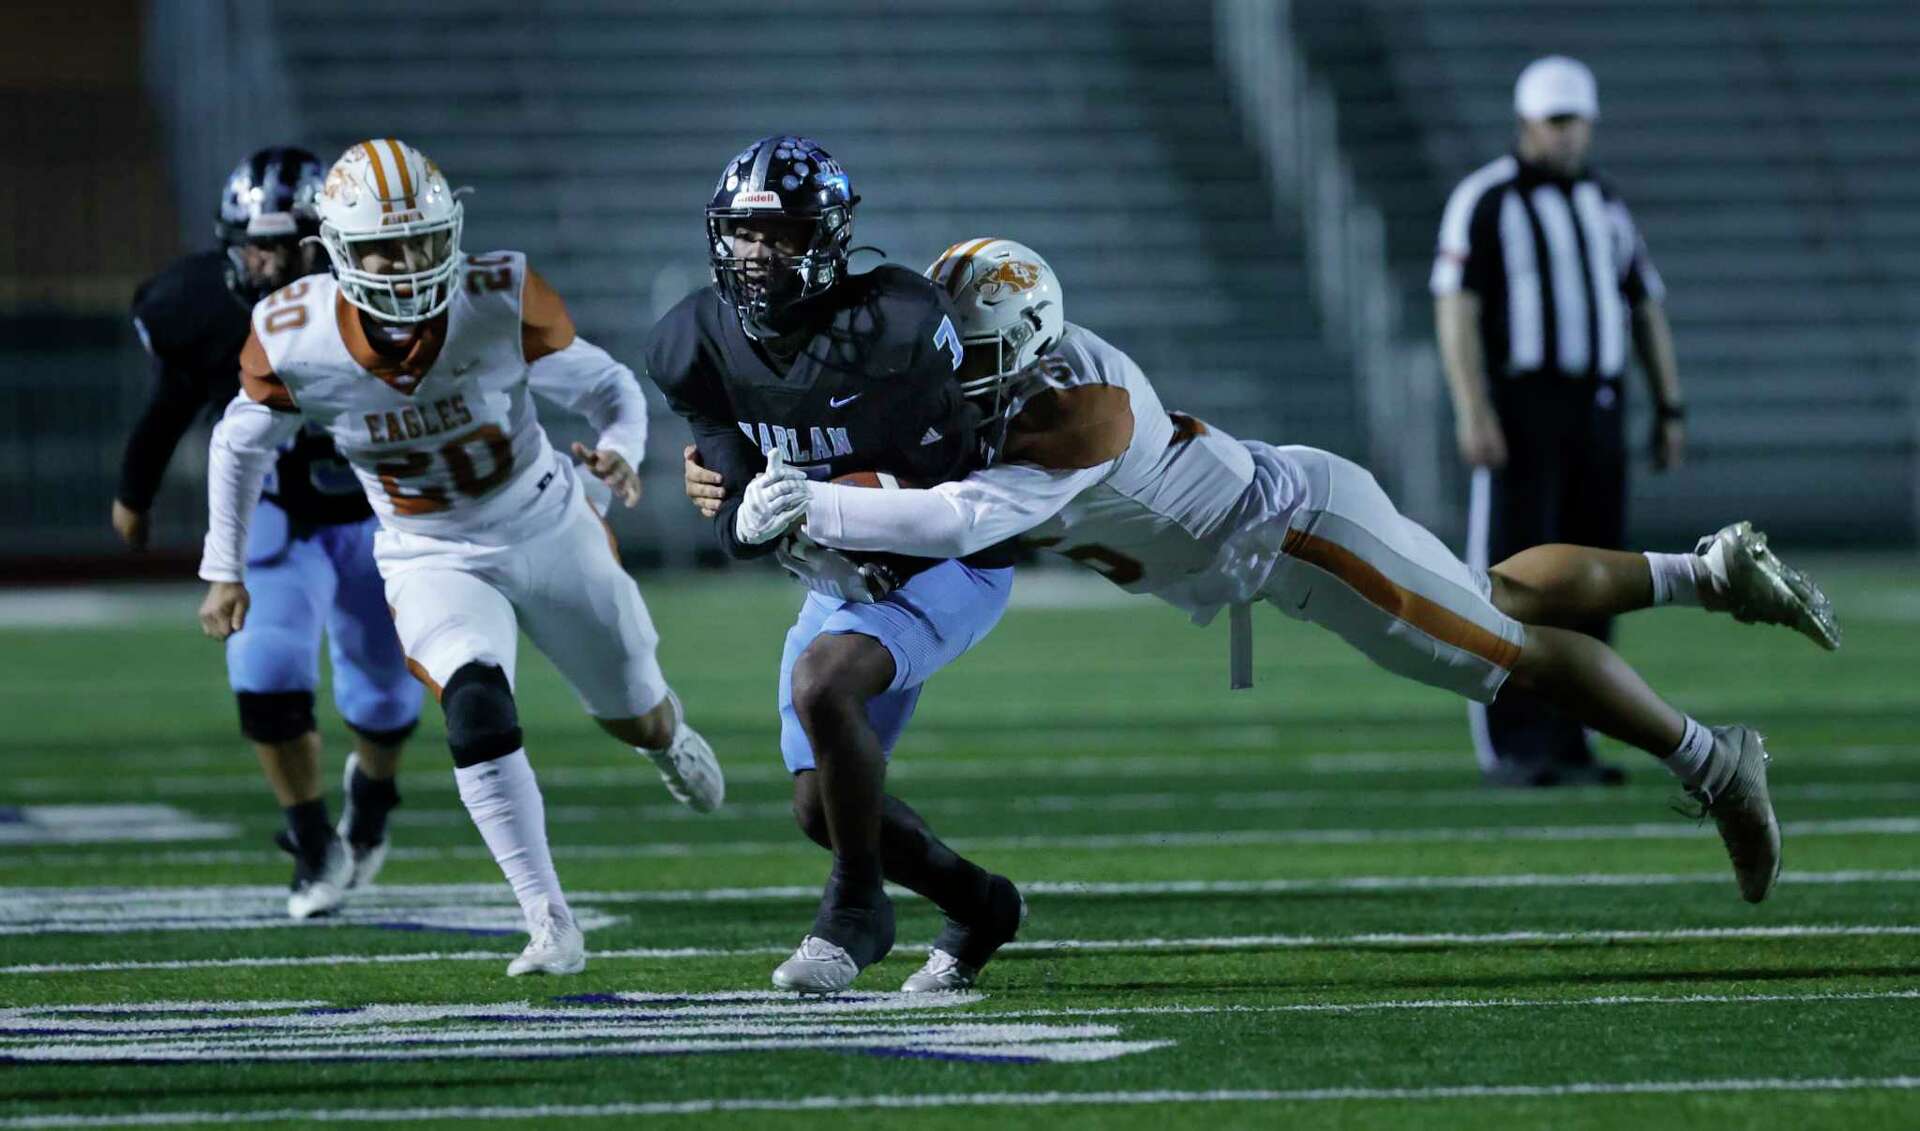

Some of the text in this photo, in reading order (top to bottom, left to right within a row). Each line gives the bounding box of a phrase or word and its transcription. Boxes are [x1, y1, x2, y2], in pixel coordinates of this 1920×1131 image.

[933, 313, 964, 371] 7
[364, 394, 473, 444] EAGLES
[374, 424, 516, 516] 20
